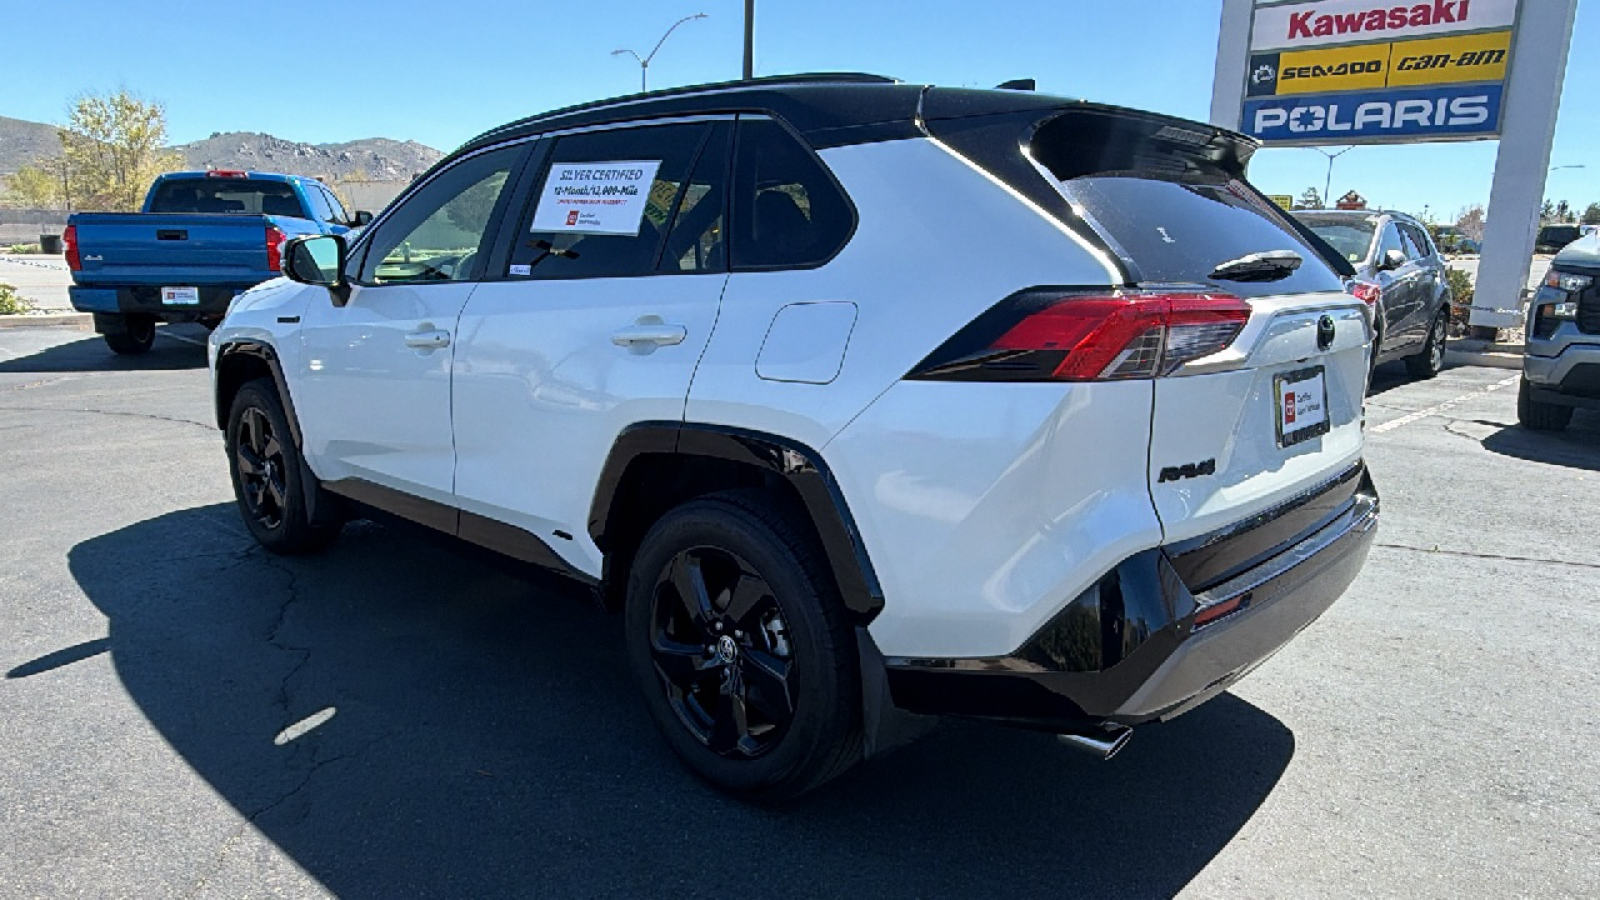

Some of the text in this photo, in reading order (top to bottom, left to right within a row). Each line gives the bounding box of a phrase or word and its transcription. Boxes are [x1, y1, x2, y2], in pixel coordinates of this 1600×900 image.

[1288, 0, 1470, 39] Kawasaki
[1254, 95, 1489, 133] POLARIS
[559, 169, 644, 181] SILVER CERTIFIED
